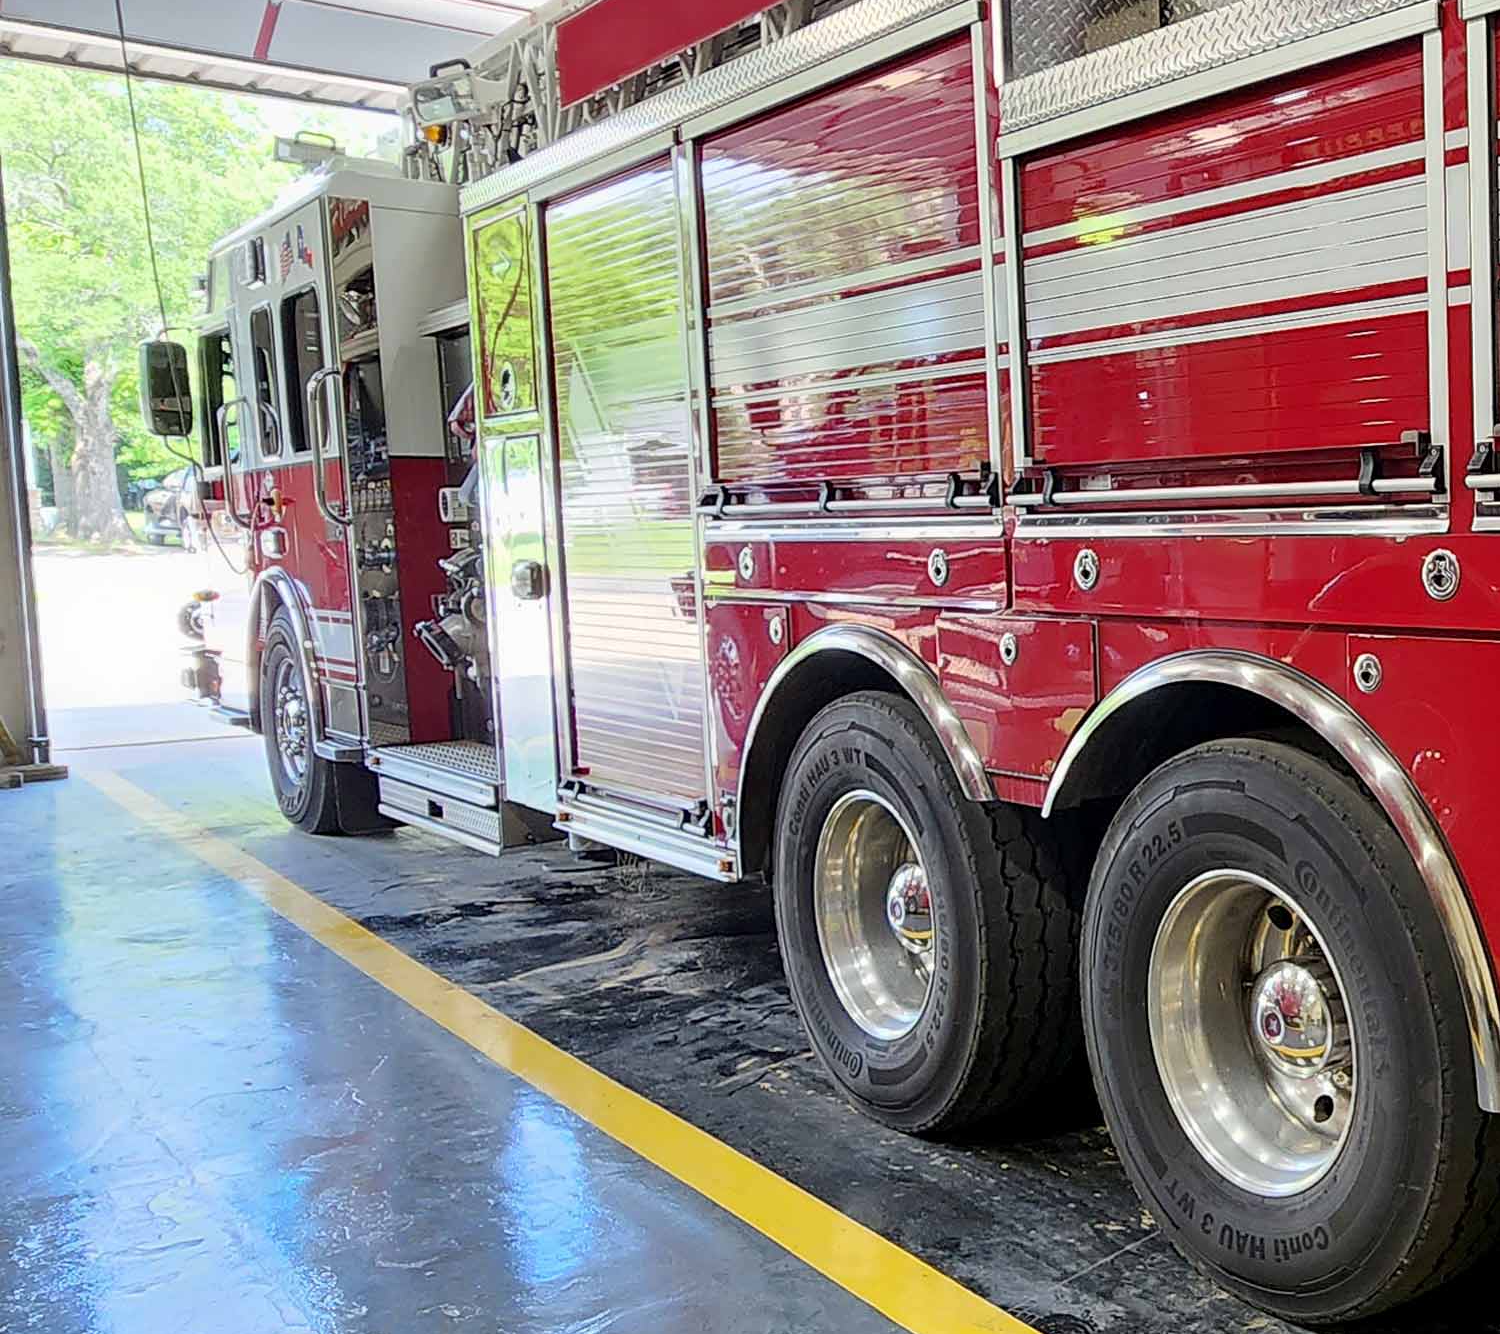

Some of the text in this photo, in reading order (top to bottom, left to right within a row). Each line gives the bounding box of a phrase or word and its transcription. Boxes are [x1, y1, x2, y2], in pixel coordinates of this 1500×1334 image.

[830, 750, 841, 765] 3
[1142, 821, 1184, 867] 22.5
[1164, 1178, 1330, 1263] Conti HAU 3 WT
